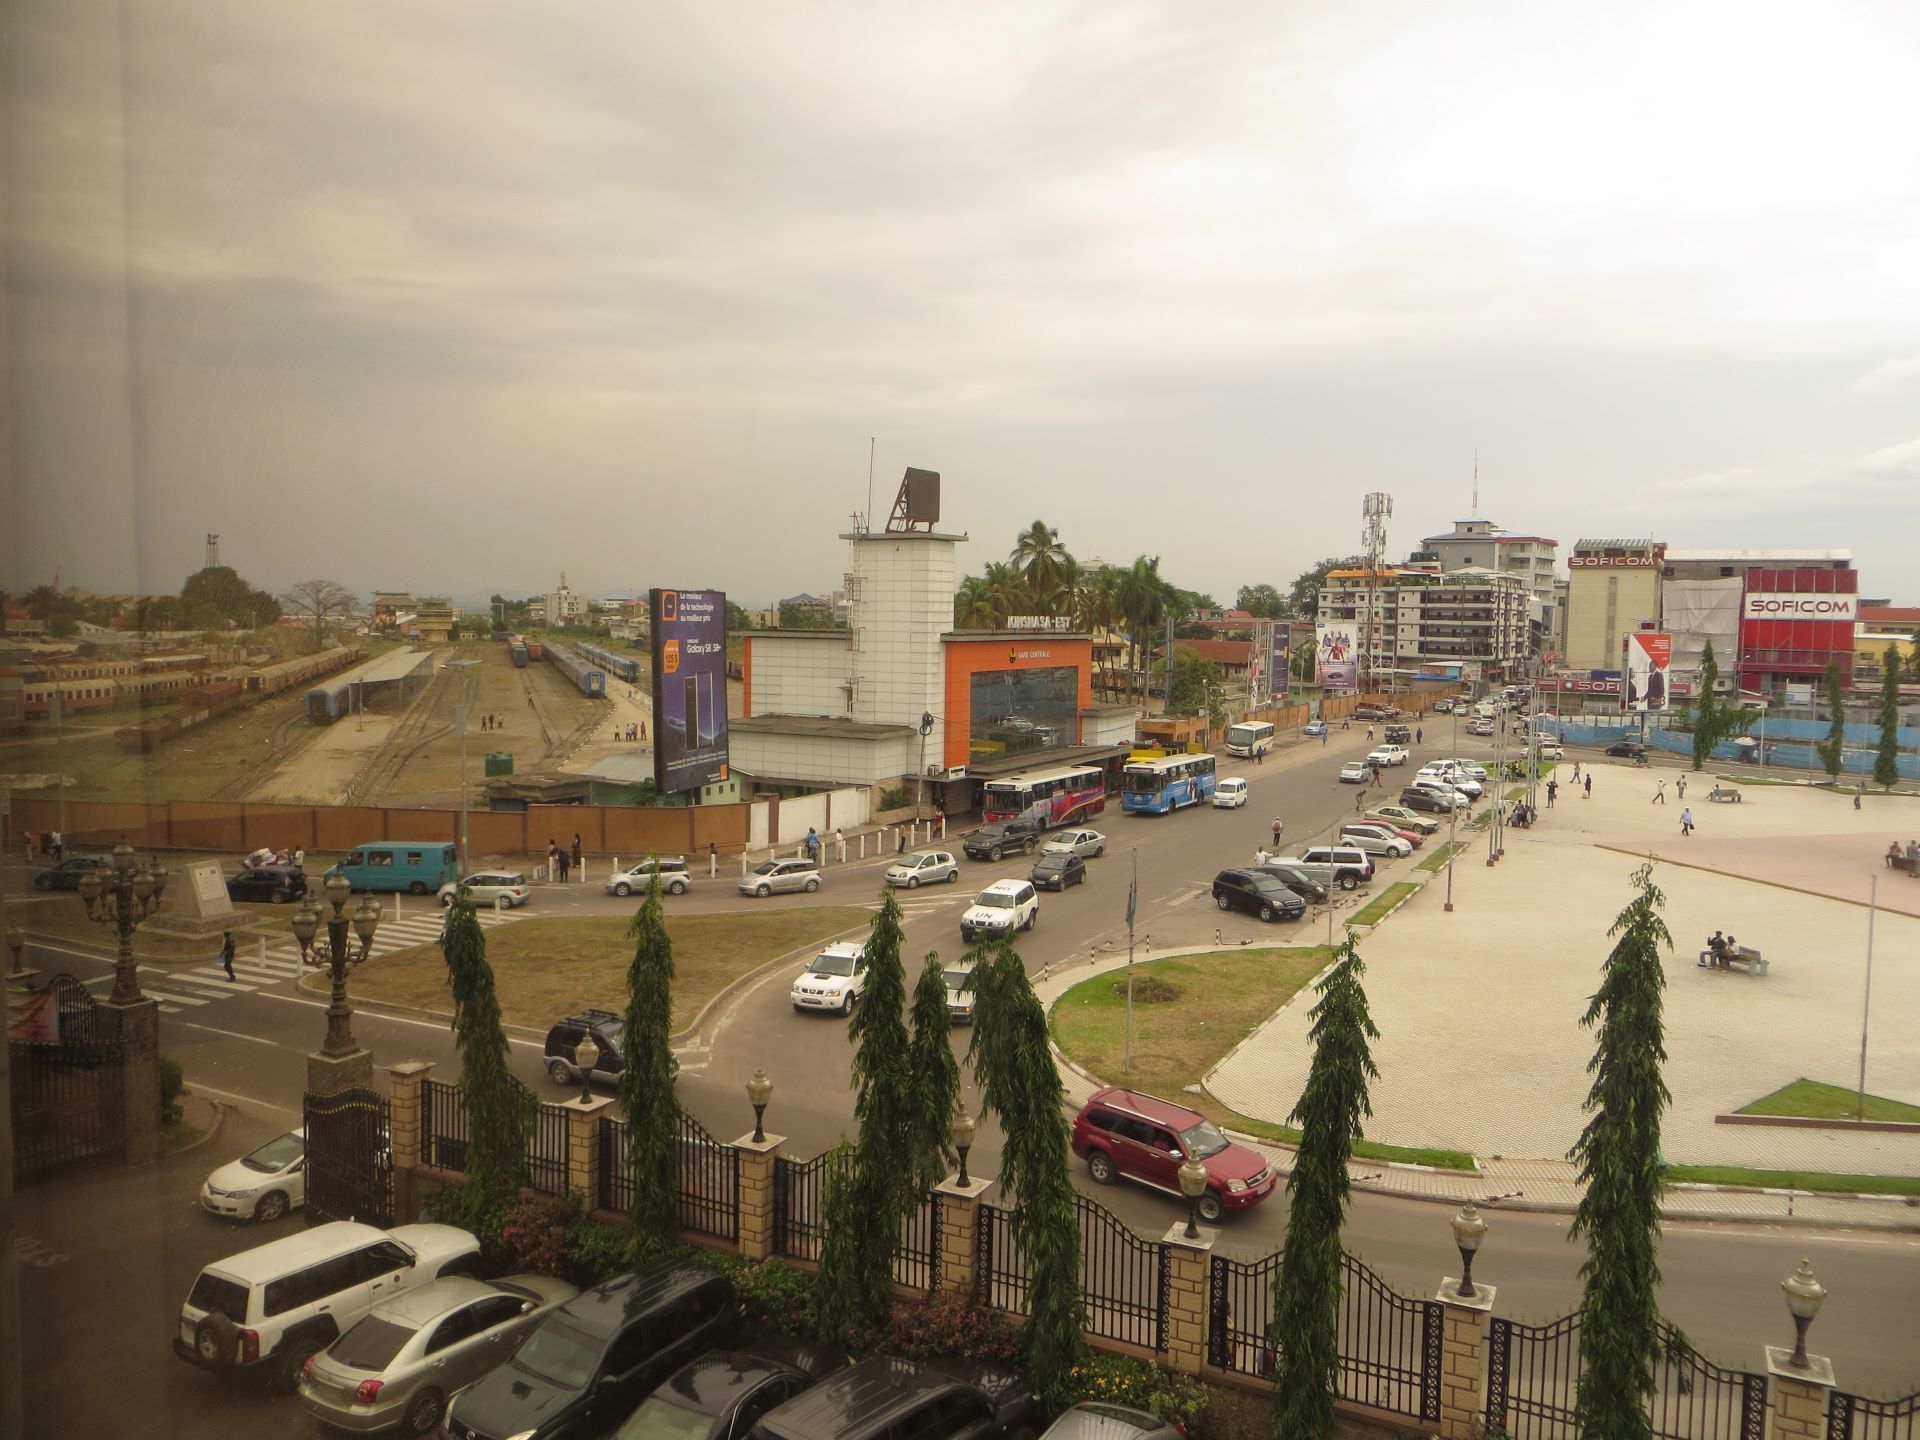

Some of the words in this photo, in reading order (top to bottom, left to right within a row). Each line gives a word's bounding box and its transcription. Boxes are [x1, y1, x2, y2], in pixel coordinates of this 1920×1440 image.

[1571, 557, 1654, 566] SOFICOM
[1750, 600, 1850, 613] SOFICOM
[1007, 616, 1071, 629] KINSHASA-EST
[687, 644, 705, 655] Galaxy
[1018, 651, 1029, 659] GARE
[1029, 650, 1050, 658] CENTRALE
